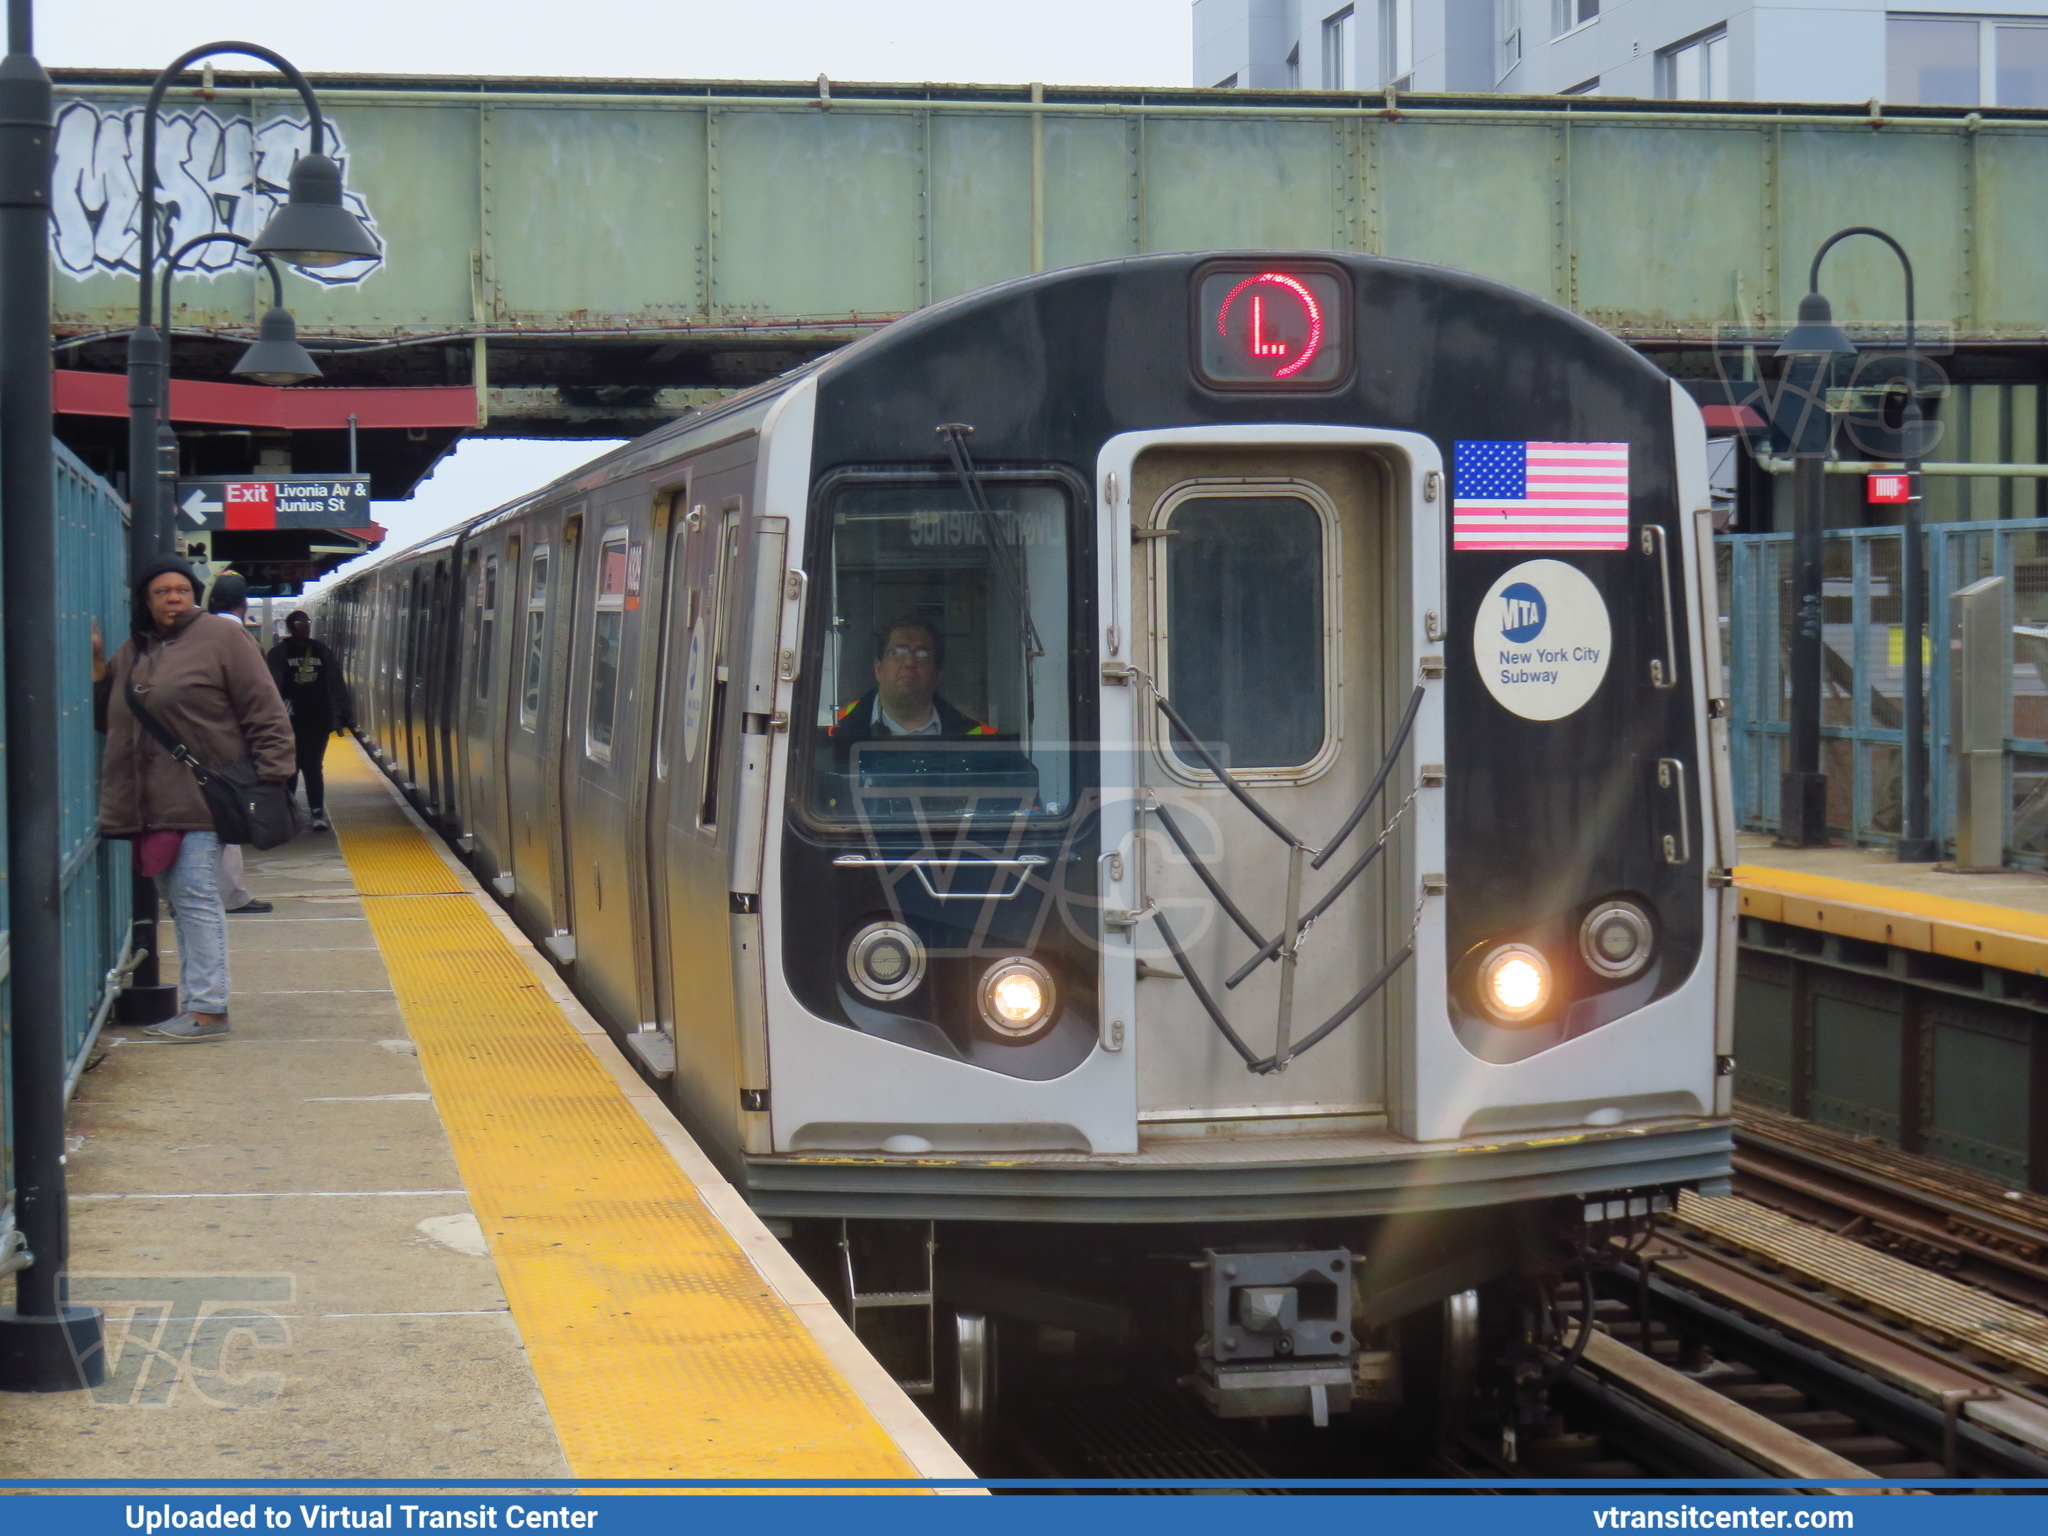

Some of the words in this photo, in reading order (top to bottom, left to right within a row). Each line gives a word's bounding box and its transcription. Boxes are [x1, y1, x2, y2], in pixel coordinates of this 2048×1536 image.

[1252, 295, 1287, 357] L
[225, 484, 269, 503] Exit
[275, 483, 328, 498] Livonia
[331, 483, 350, 497] Av
[354, 482, 367, 497] &
[276, 499, 324, 513] Junius
[328, 498, 346, 512] St
[1499, 596, 1541, 632] MTA
[1499, 650, 1532, 665] New
[1536, 648, 1568, 663] York
[1572, 646, 1601, 664] City
[1500, 669, 1558, 684] Subway
